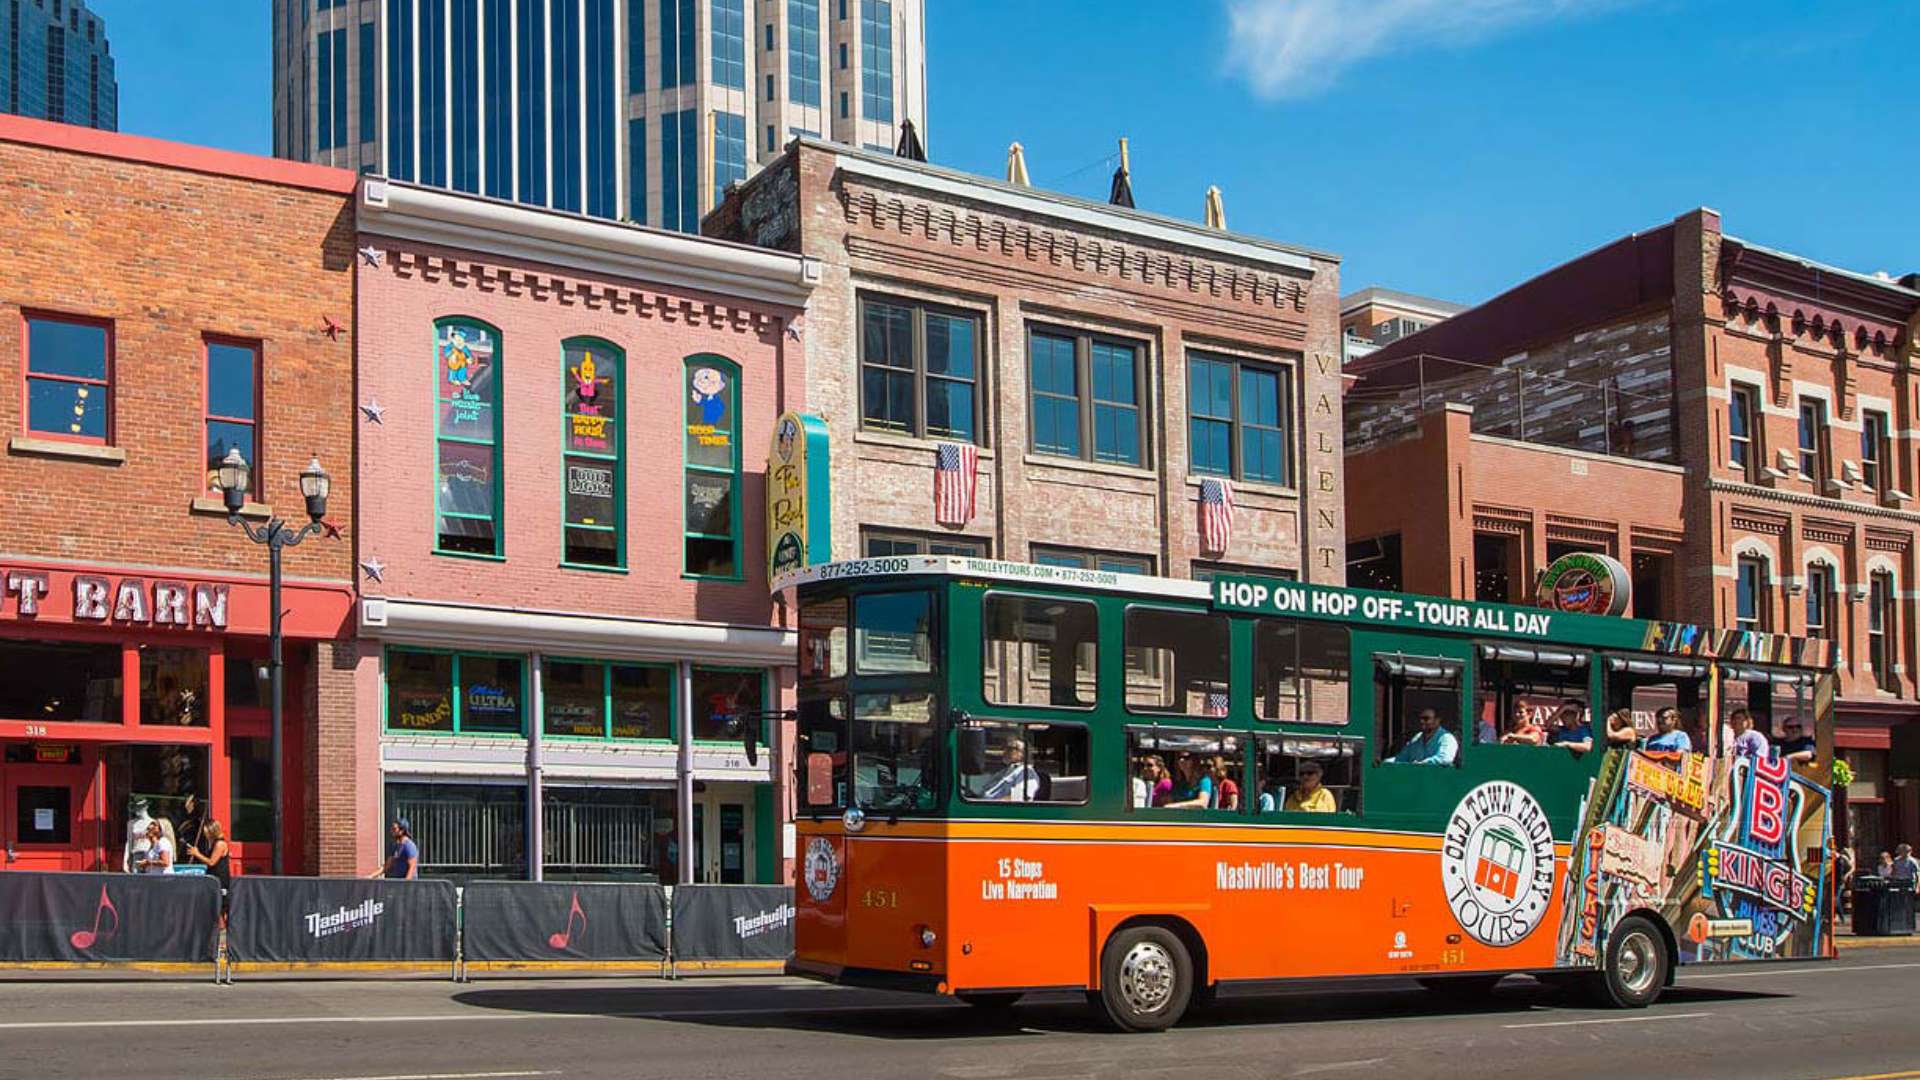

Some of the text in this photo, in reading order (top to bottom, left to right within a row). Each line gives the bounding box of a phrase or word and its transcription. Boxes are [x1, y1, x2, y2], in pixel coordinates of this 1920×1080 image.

[820, 559, 909, 579] 877-252-5009
[966, 559, 1053, 578] TROLLEYTOURS.COM
[75, 575, 229, 628] BARN
[1220, 581, 1268, 608] HOP
[1274, 587, 1305, 612] ON
[1311, 591, 1357, 616] HOP
[1474, 607, 1510, 632] ALL
[1514, 612, 1551, 636] DAY
[469, 695, 516, 708] ULTRA
[25, 725, 47, 736] 318
[1445, 814, 1472, 861] OLD
[1464, 784, 1515, 822] TOWN
[1517, 795, 1554, 901] TROLLEY
[998, 858, 1042, 880] 15 Stops
[1216, 862, 1365, 889] Nashville's Best Tour
[1719, 848, 1804, 909] KING'S
[863, 891, 897, 908] 451
[982, 880, 1057, 899] Live Narration
[304, 899, 384, 937] Nashville
[1451, 876, 1529, 943] TOURS
[1442, 948, 1465, 964] 451
